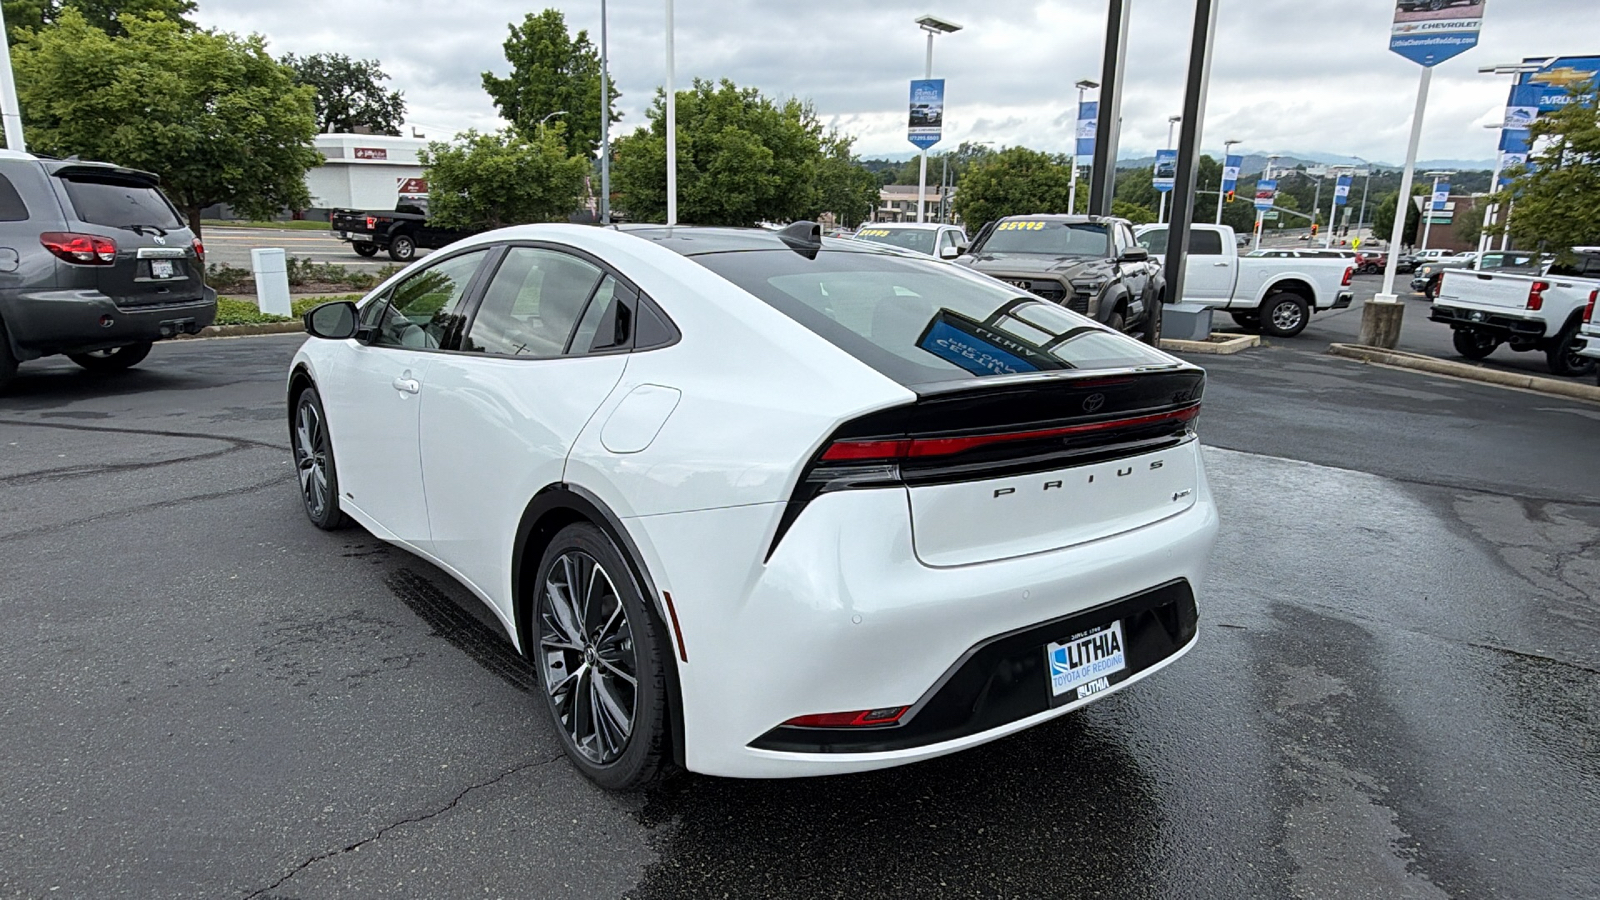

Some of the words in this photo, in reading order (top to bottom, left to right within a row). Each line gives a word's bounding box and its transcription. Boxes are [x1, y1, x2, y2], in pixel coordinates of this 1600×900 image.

[1421, 21, 1478, 30] CHEVROLET
[993, 460, 1164, 498] PRIUS
[1067, 630, 1121, 670] LITHIA
[1053, 670, 1080, 687] TOYOTA
[1081, 665, 1091, 677] OF
[1092, 655, 1123, 673] REDDING
[1084, 676, 1110, 695] LITHIA
